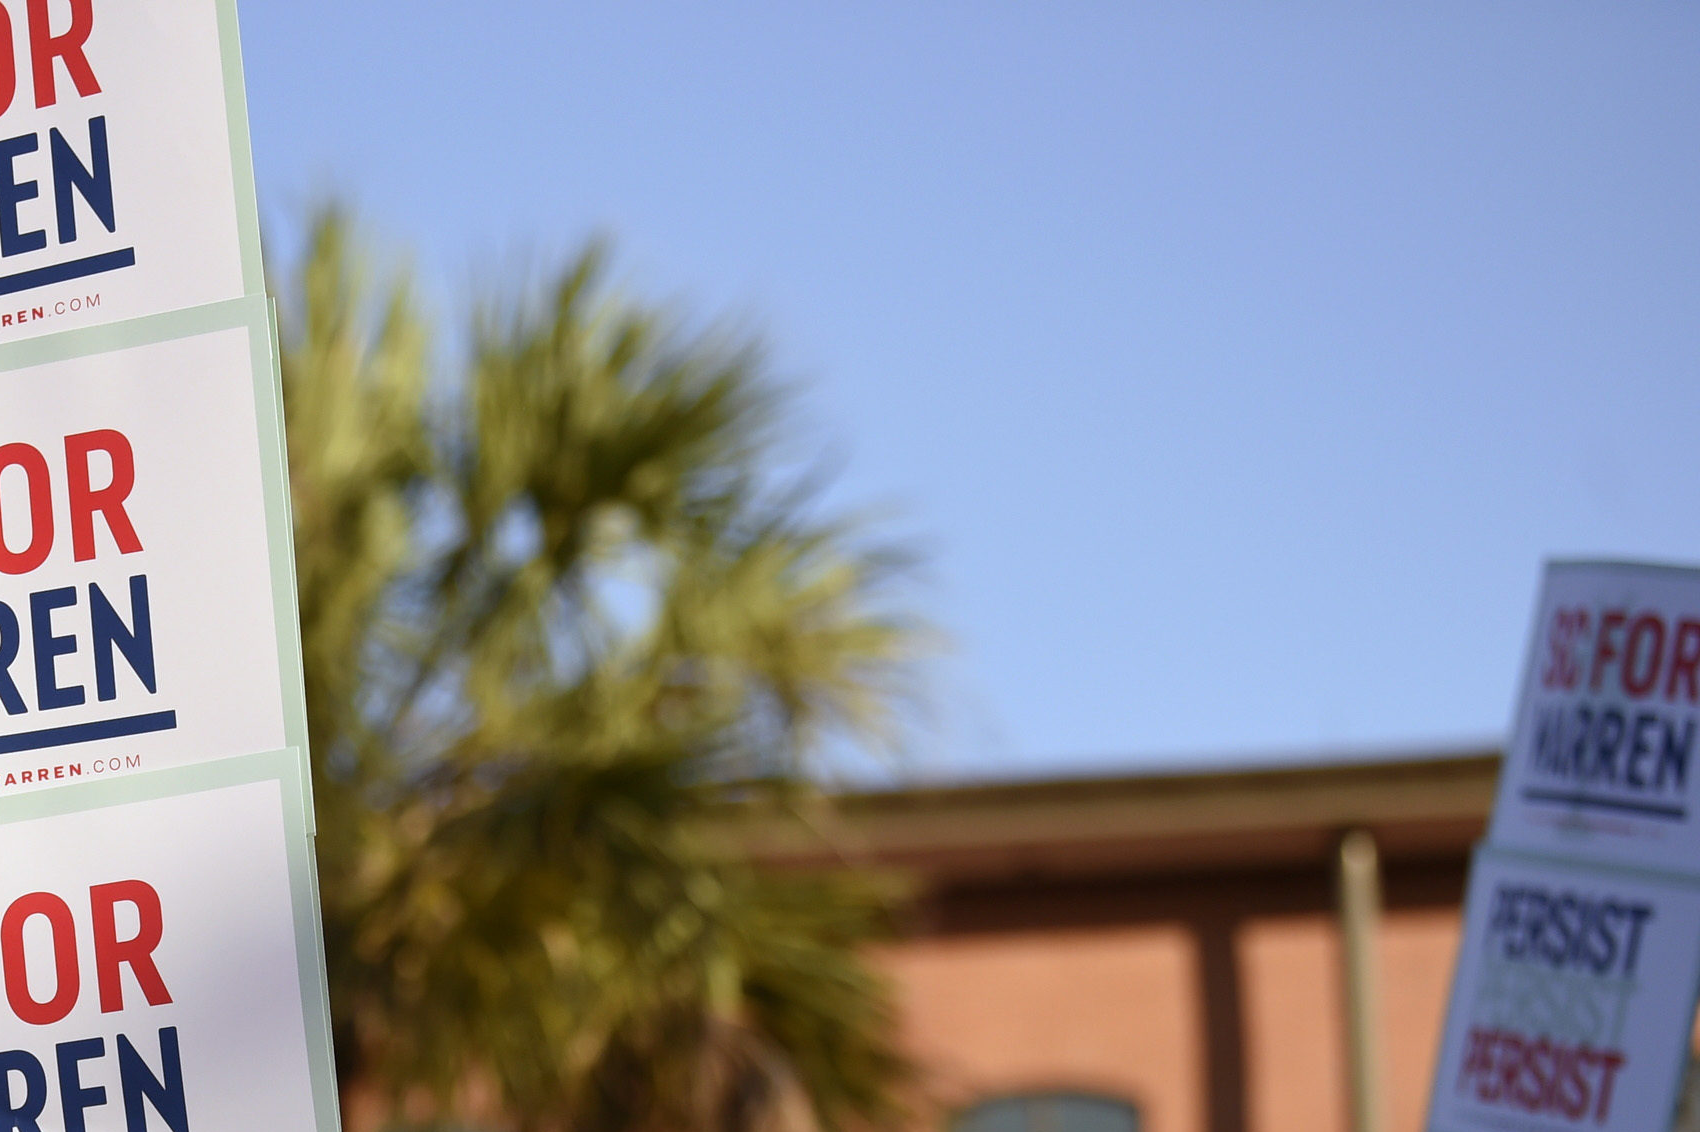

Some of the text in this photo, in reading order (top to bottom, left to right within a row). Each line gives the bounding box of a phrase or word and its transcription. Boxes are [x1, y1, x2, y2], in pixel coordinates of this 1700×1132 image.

[1591, 608, 1700, 706] FOR
[1531, 704, 1696, 795] WARREN
[1487, 885, 1654, 978] PERSIST
[1457, 1026, 1627, 1125] PERSIST
